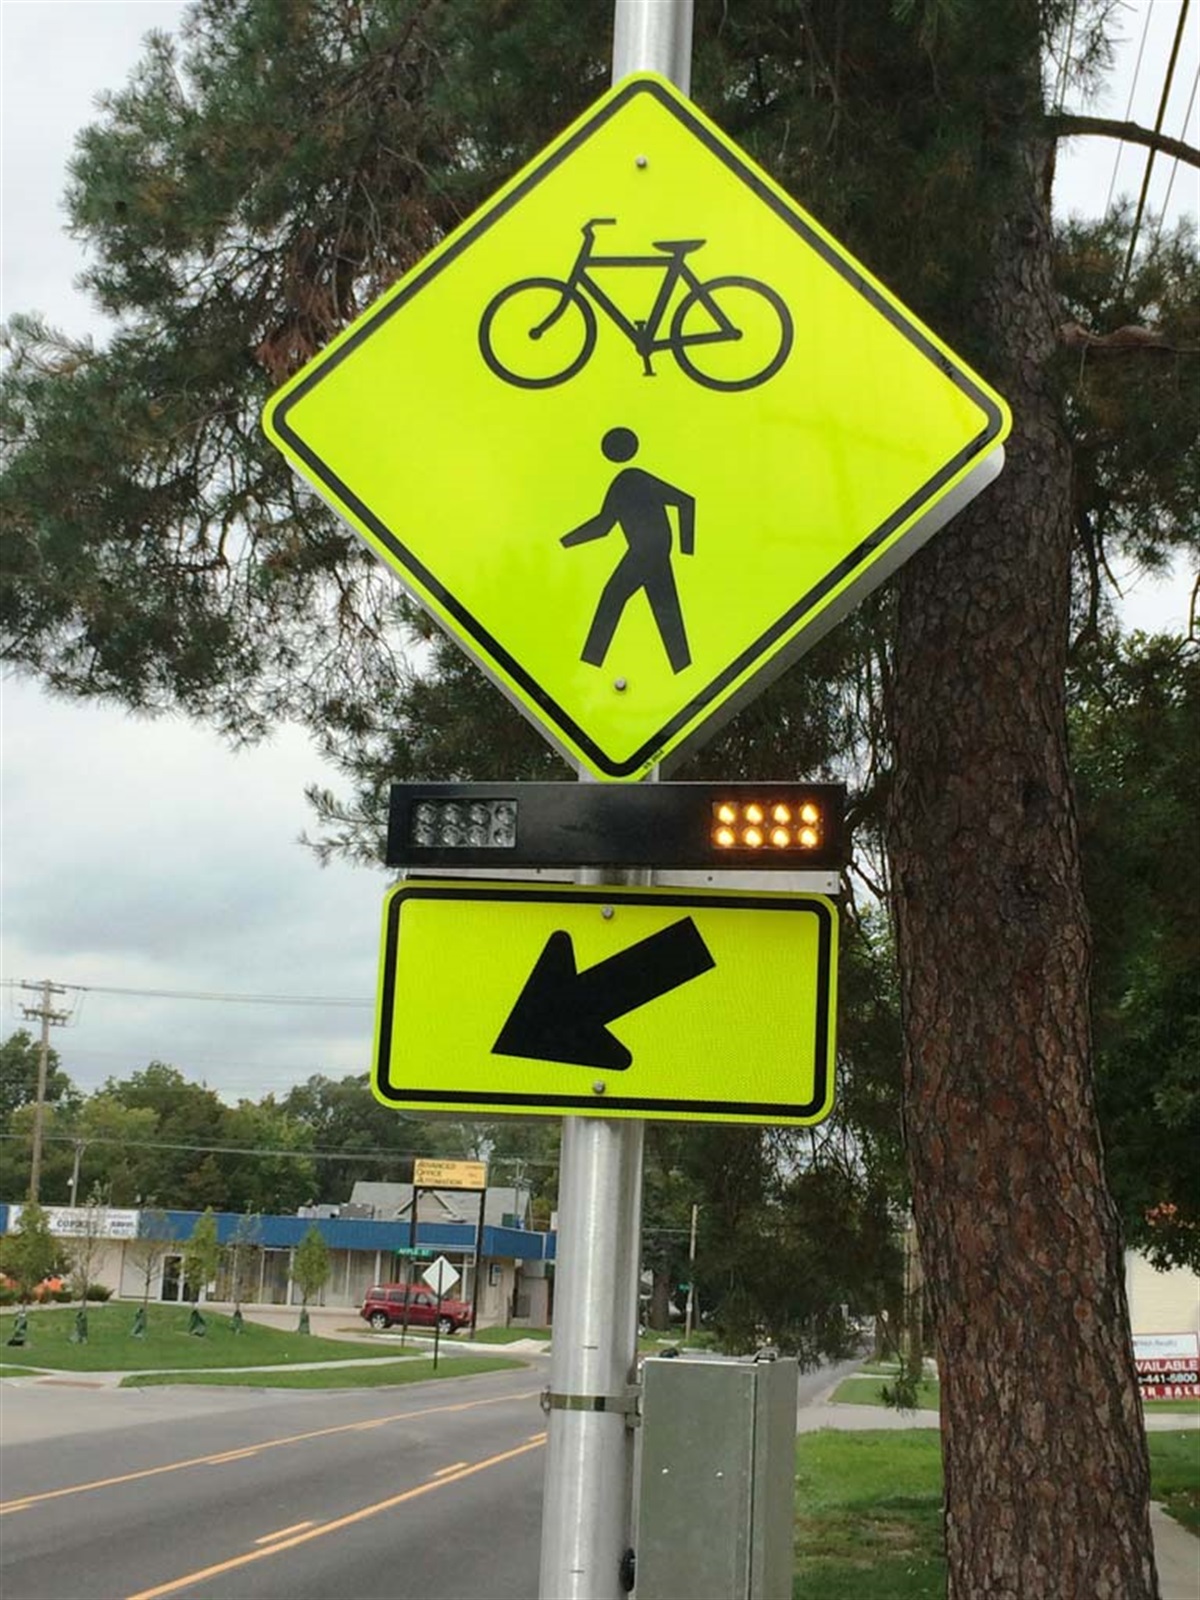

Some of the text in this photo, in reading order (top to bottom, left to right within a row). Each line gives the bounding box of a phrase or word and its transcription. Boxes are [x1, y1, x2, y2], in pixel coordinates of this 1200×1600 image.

[417, 1162, 456, 1170] ADVANCED
[416, 1168, 442, 1176] OFFICE
[1134, 1360, 1199, 1372] VAILABLE
